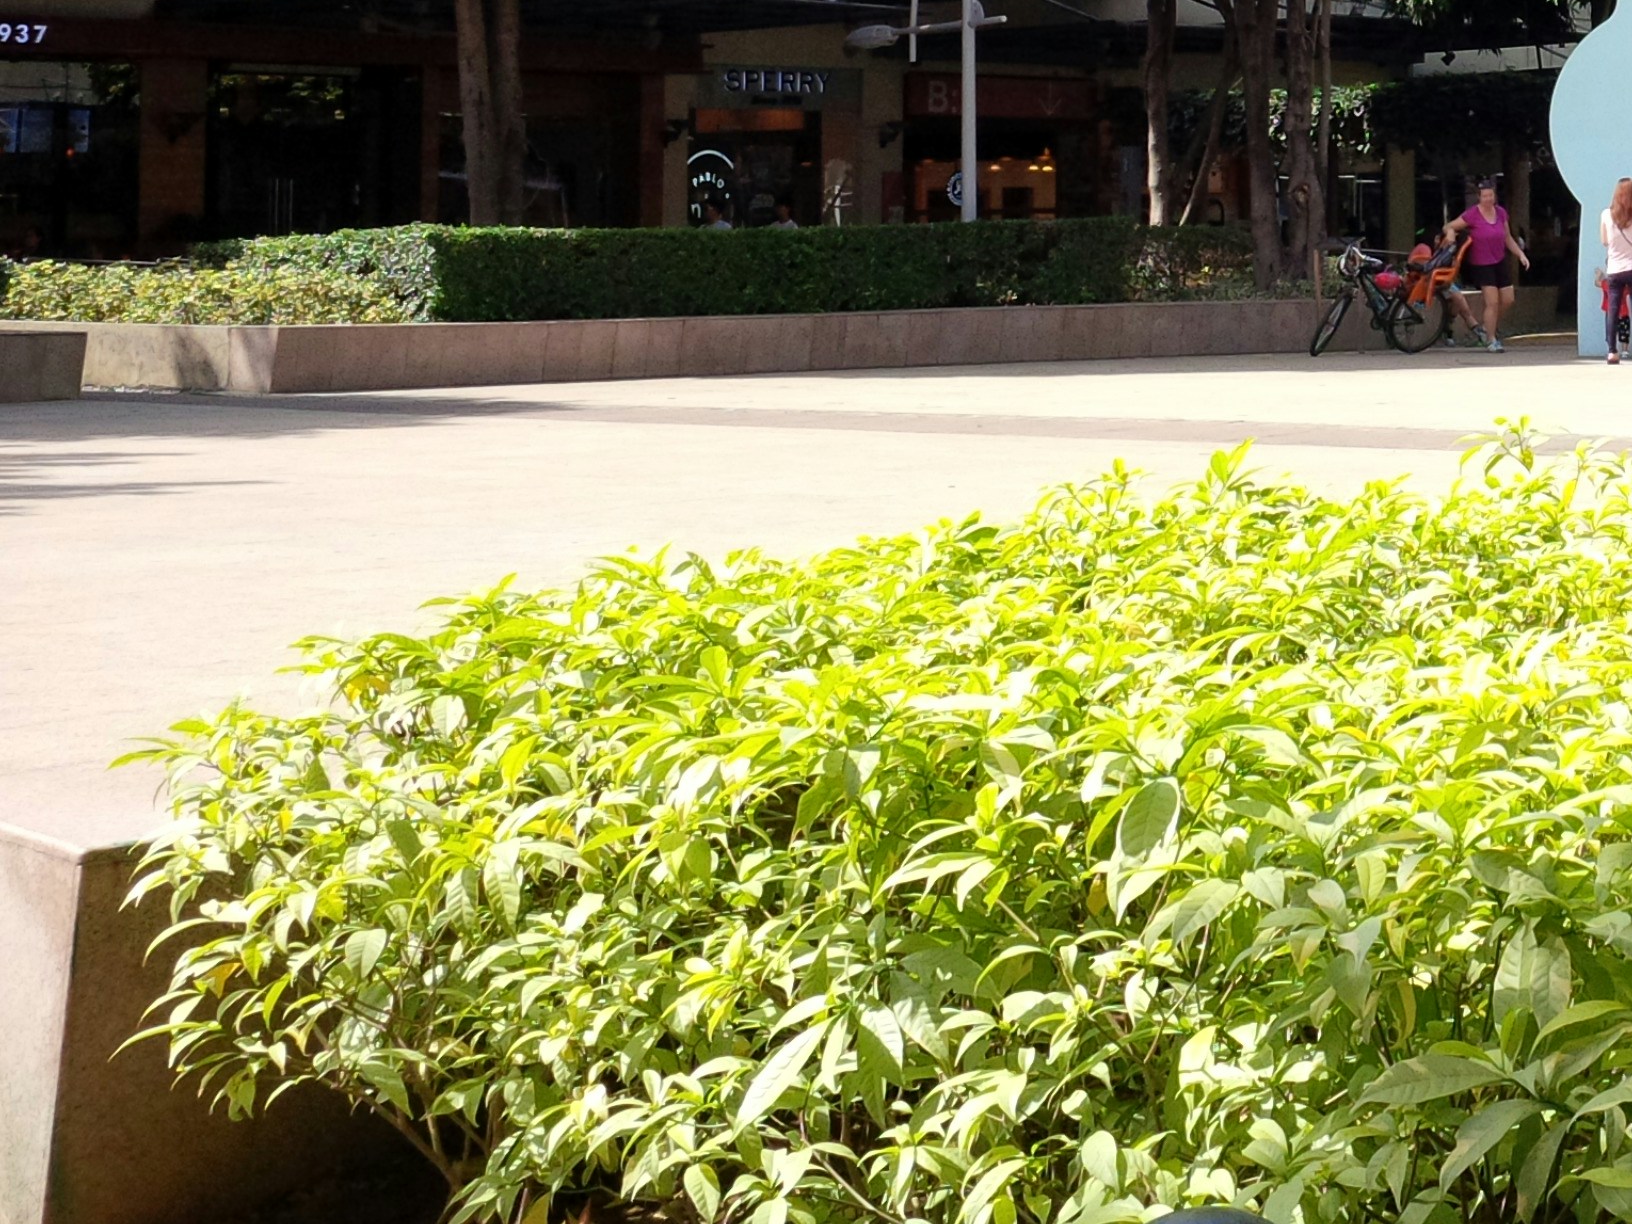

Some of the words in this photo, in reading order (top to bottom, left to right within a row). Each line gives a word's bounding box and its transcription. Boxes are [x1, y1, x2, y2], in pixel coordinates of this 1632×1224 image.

[0, 23, 47, 43] 937
[724, 69, 828, 93] SPERRY
[692, 172, 725, 188] PABLO
